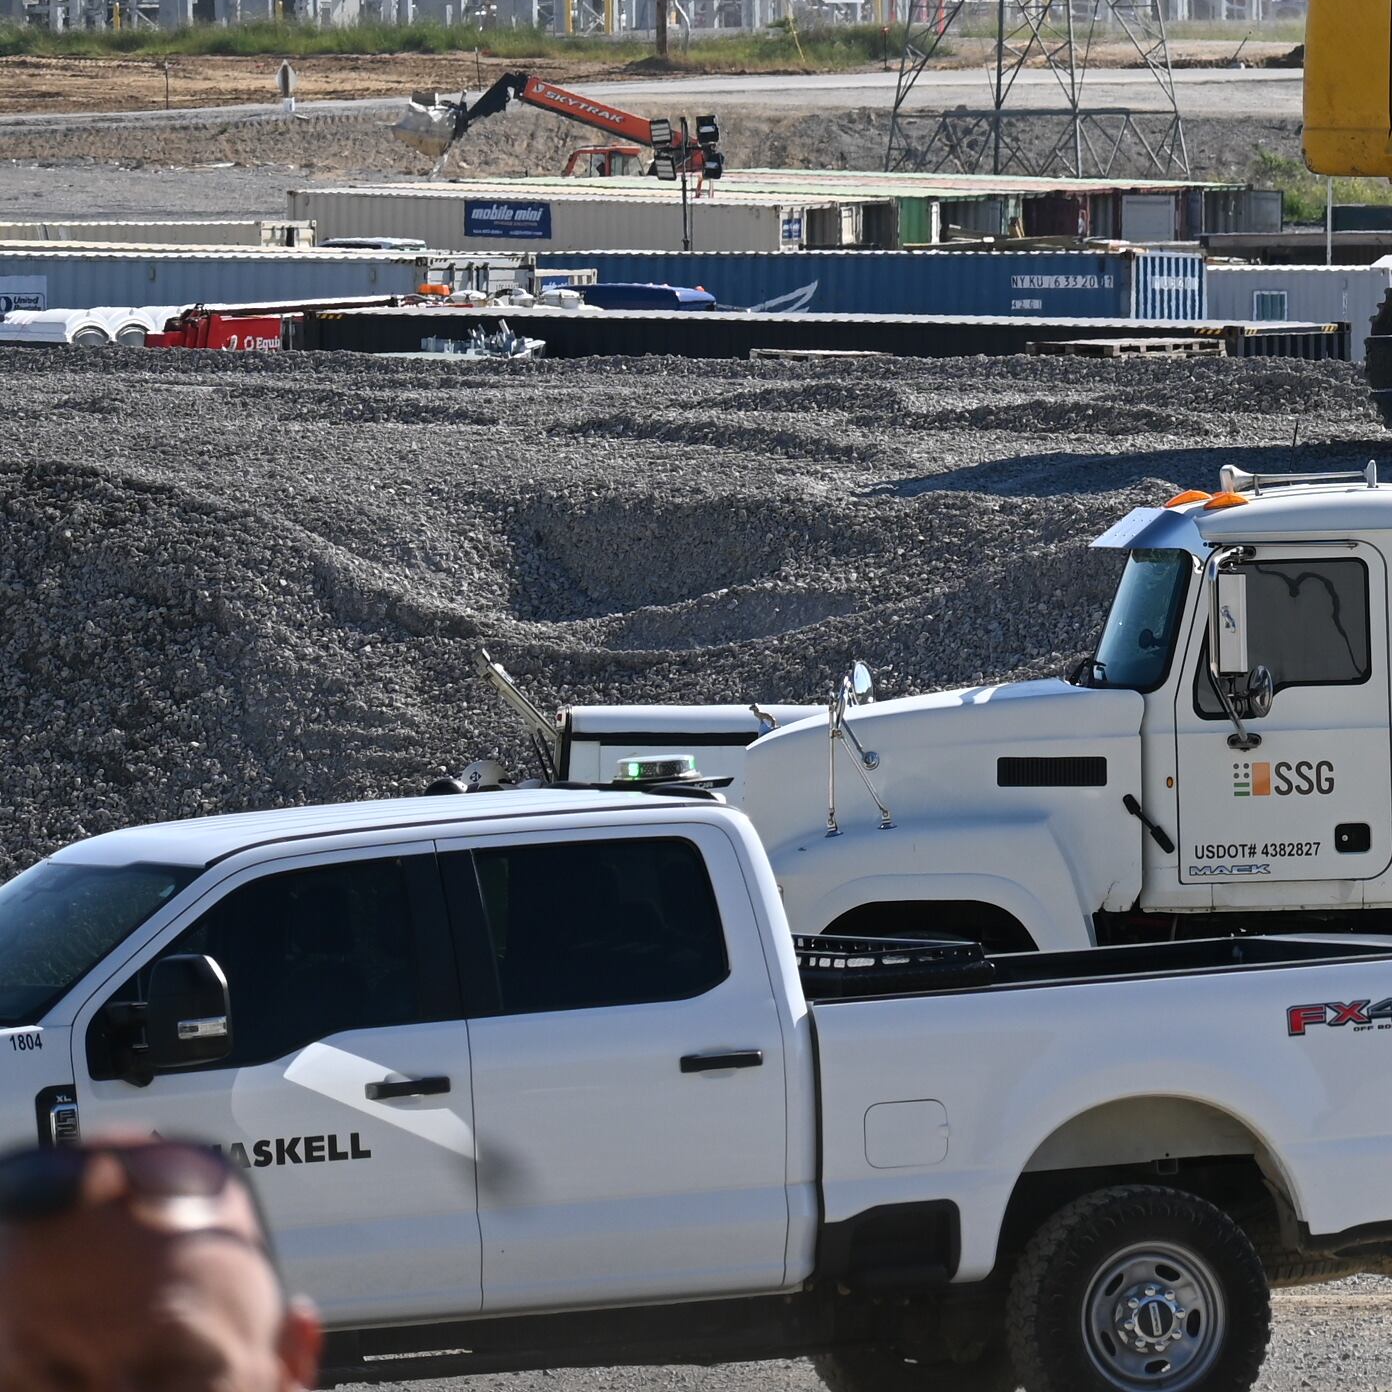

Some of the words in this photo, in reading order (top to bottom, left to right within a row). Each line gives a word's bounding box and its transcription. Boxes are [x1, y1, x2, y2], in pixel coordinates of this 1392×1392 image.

[544, 90, 625, 124] SKYTRAK
[471, 204, 513, 220] mobile
[514, 207, 543, 221] mini
[1012, 275, 1044, 288] NYKU
[1274, 761, 1335, 796] SSG
[1194, 844, 1257, 859] USDOT#
[1261, 842, 1321, 857] 4382827
[1189, 864, 1271, 876] MACK
[9, 1033, 43, 1051] 1804
[56, 1095, 72, 1103] XL
[212, 1133, 372, 1169] ASKELL
